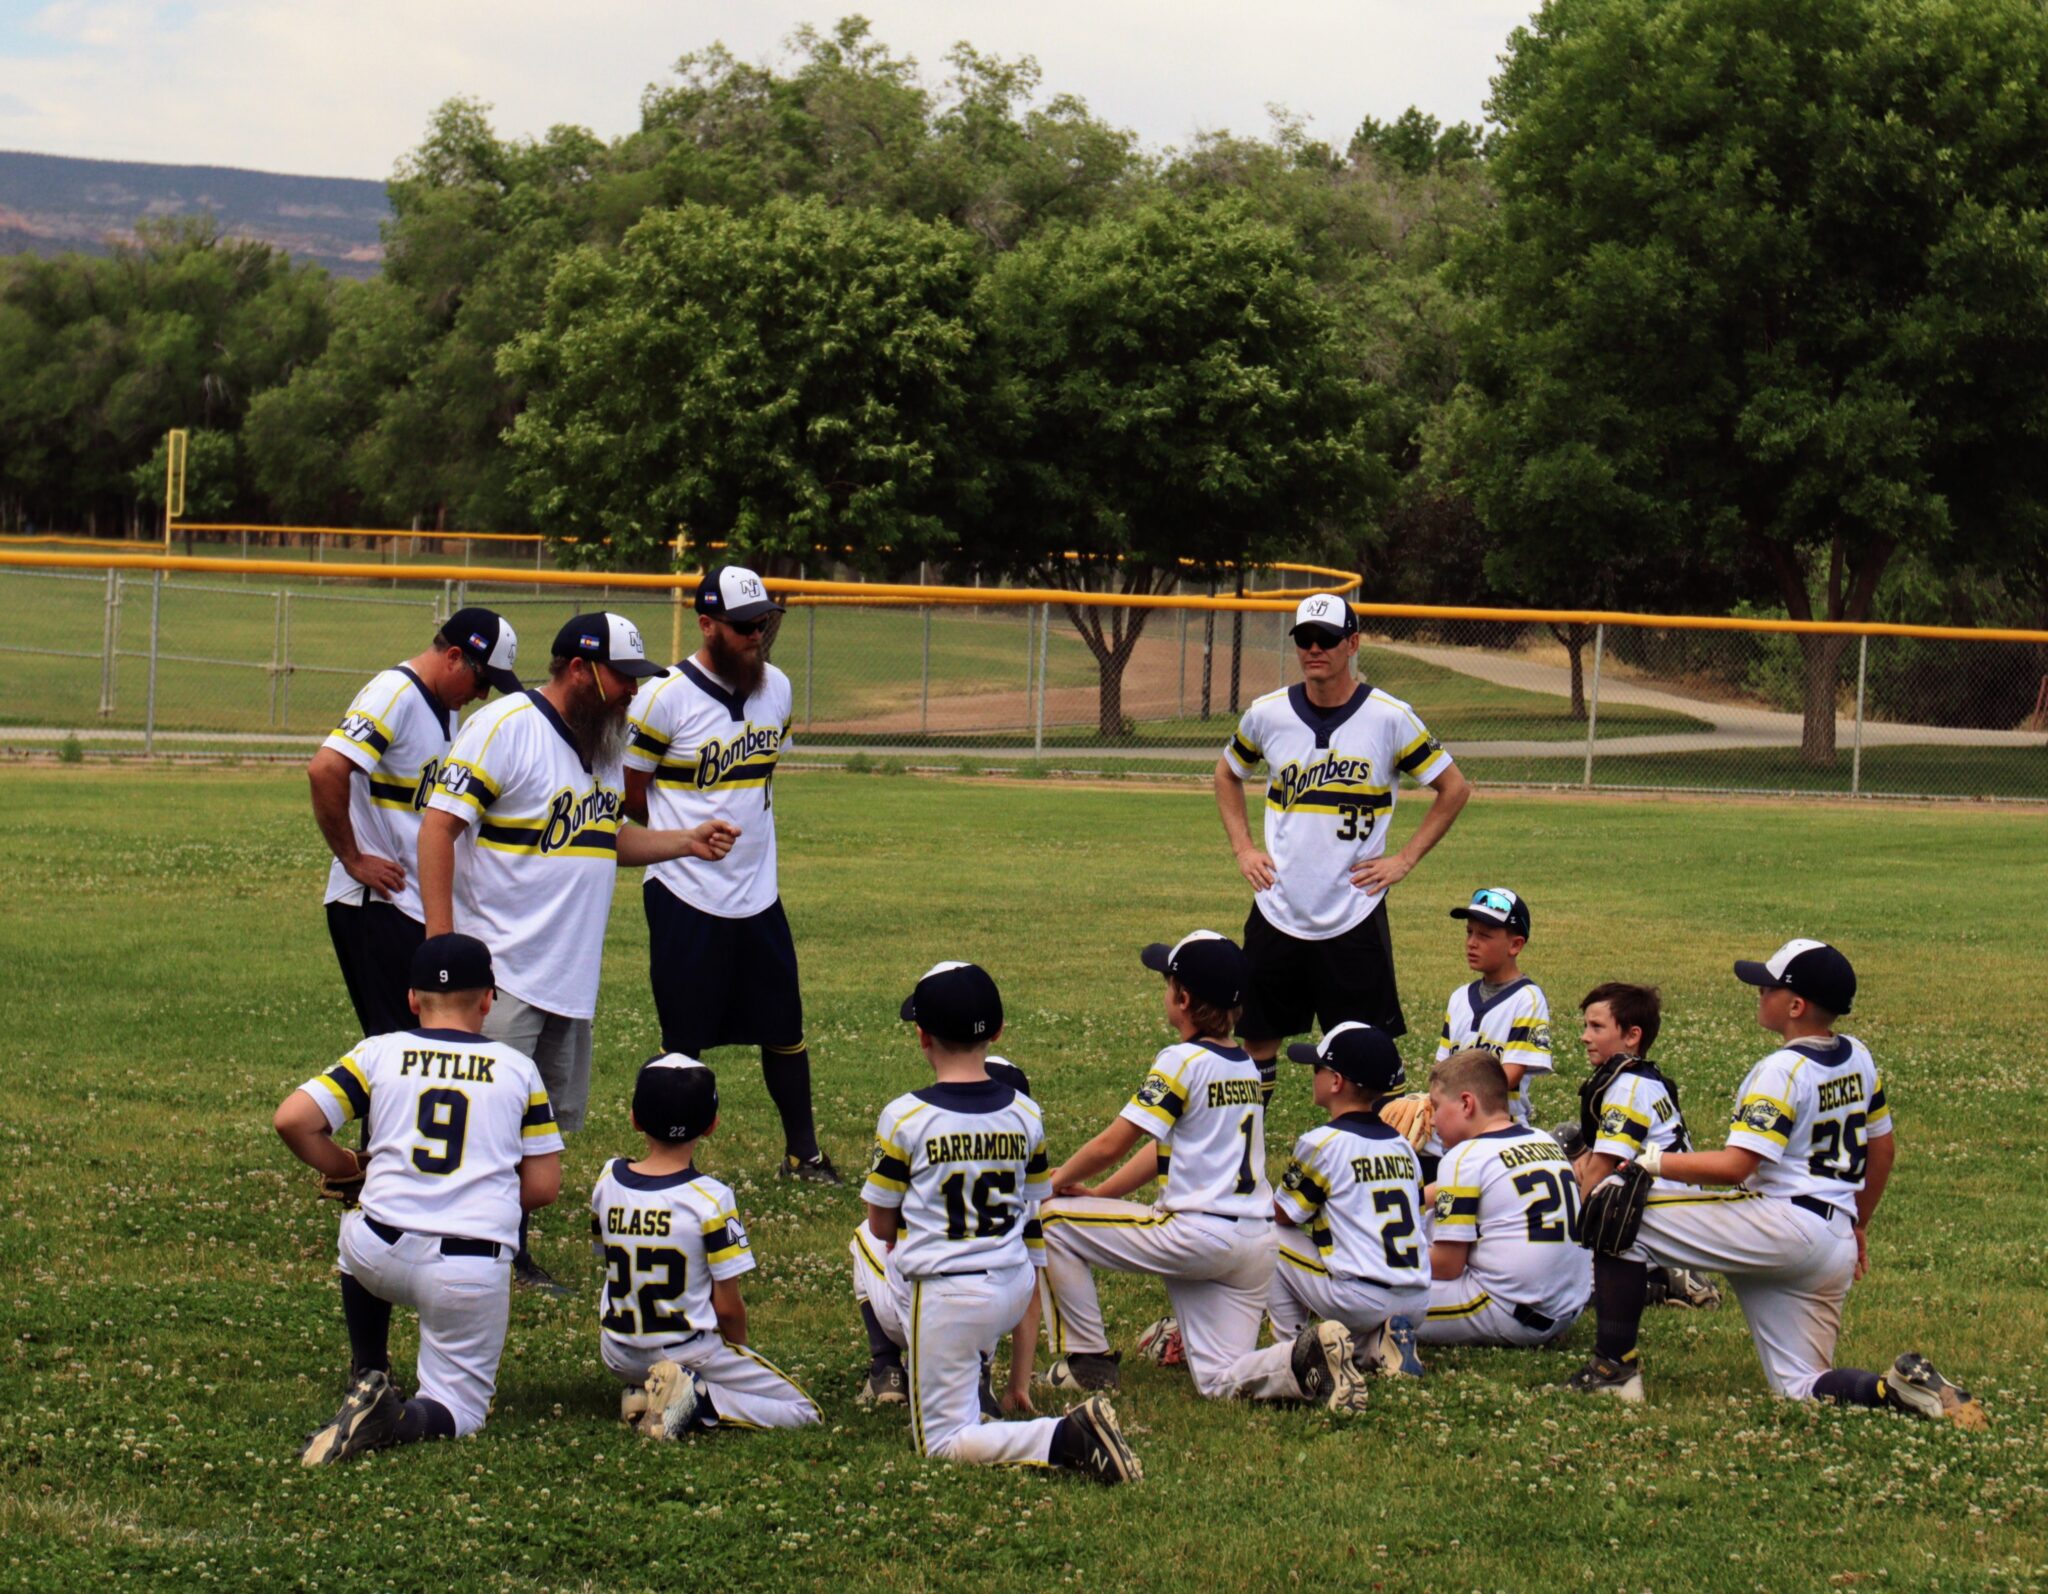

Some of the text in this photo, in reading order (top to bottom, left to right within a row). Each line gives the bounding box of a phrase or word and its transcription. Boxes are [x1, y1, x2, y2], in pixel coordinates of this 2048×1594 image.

[696, 725, 779, 789] Bombers
[1280, 753, 1371, 809] Bombers
[1336, 804, 1376, 841] 33
[439, 970, 449, 983] 9
[973, 1021, 986, 1034] 16
[400, 1050, 496, 1084] PYTLIK
[412, 1086, 470, 1176] 9
[669, 1126, 686, 1137] 22
[925, 1132, 1028, 1165] GARRAMONE
[1234, 1111, 1257, 1195] 1
[1351, 1155, 1415, 1183] FRANCIS
[1499, 1142, 1568, 1169] GARDNE
[607, 1207, 672, 1237] GLASS
[940, 1169, 1016, 1241] 16
[1372, 1187, 1420, 1269] 2
[601, 1244, 693, 1335] 22
